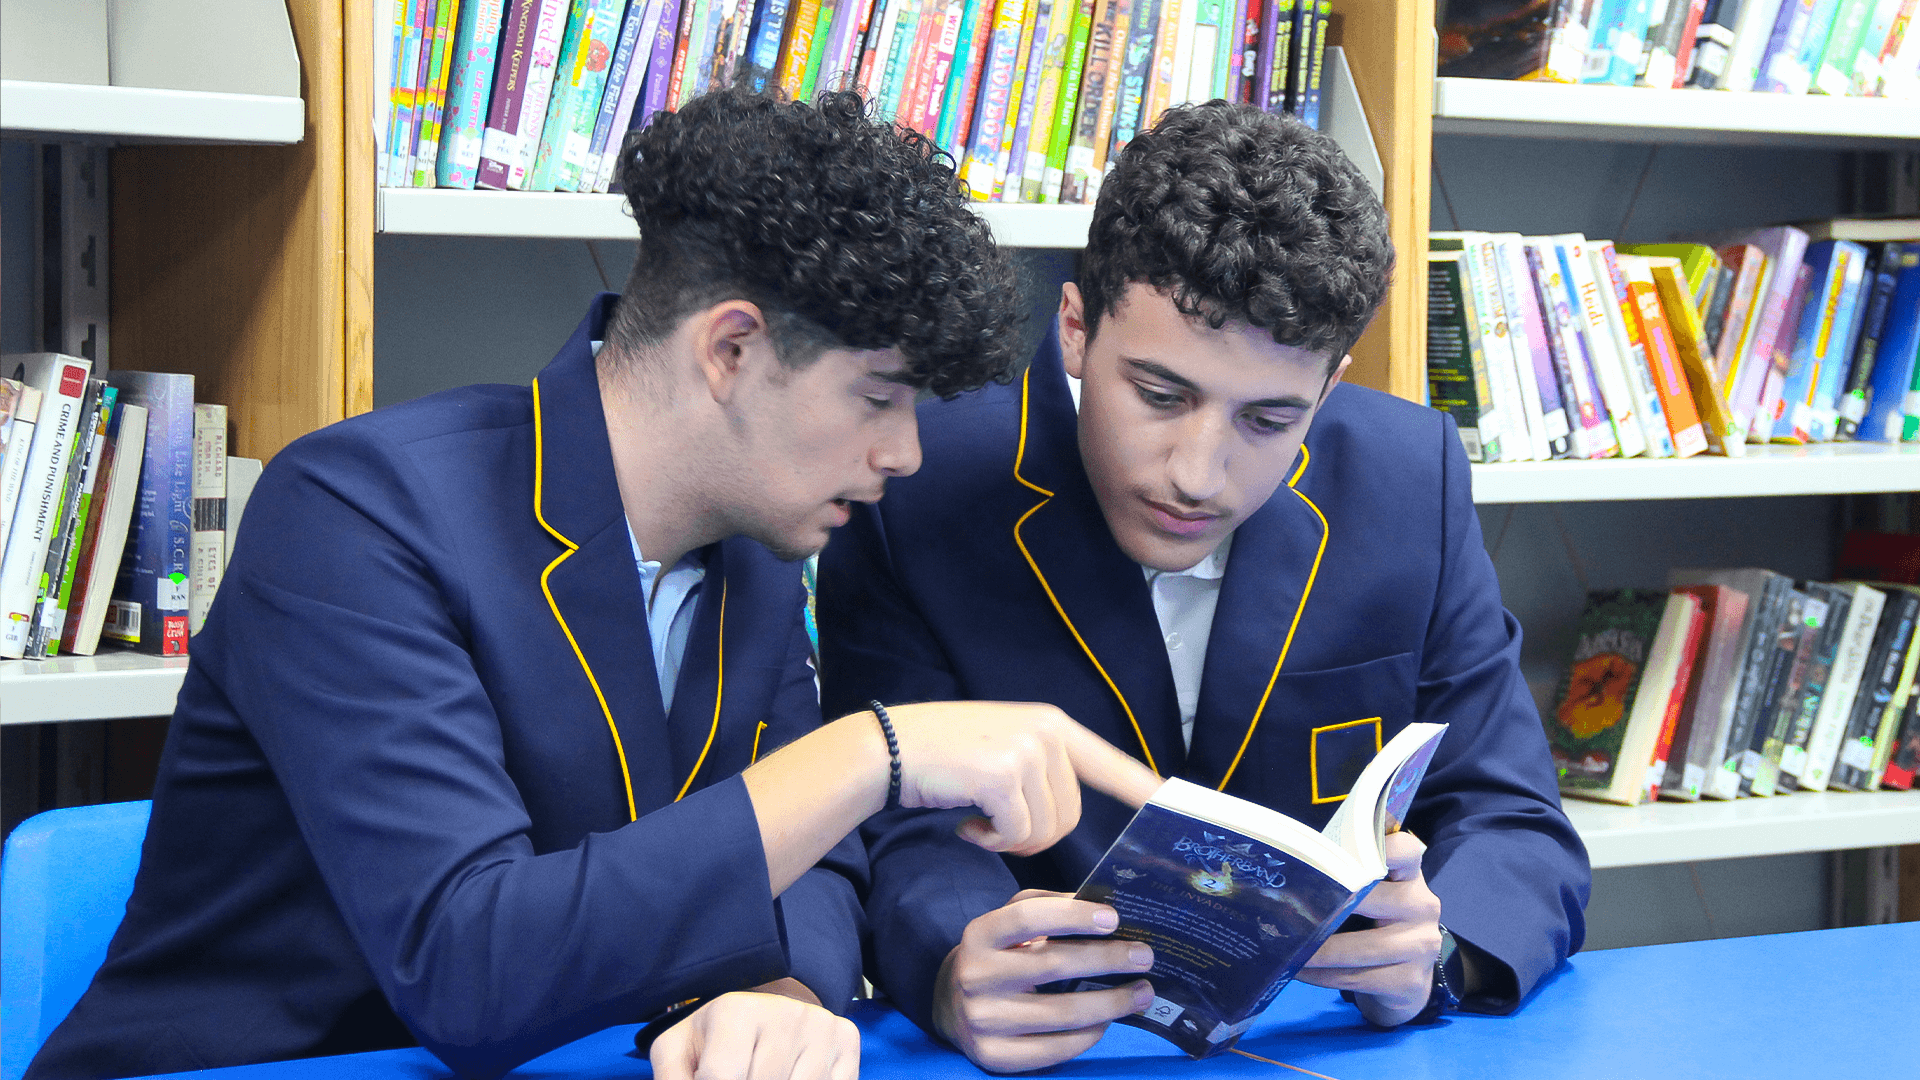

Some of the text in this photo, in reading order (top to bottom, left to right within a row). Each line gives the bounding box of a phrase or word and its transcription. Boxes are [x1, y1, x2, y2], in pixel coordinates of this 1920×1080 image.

[474, 2, 489, 42] sions
[942, 13, 958, 46] WILD
[503, 48, 522, 91] KEEPERS
[617, 47, 630, 62] in
[1110, 59, 1120, 70] in
[611, 62, 626, 83] the
[920, 72, 931, 84] in
[1069, 69, 1080, 81] in
[1078, 22, 1114, 138] KILL ORDER
[1106, 71, 1118, 88] the
[467, 70, 484, 128] LIZ RETTI
[603, 83, 620, 115] Field
[975, 43, 1018, 151] LIONBOY
[1065, 81, 1078, 100] the
[1060, 100, 1074, 126] Barn
[1580, 281, 1605, 327] Heidi
[32, 402, 71, 542] CRIME AND PUNISHMENT
[174, 450, 189, 476] Like
[213, 434, 222, 477] RICHARD
[171, 480, 188, 512] Light
[172, 536, 184, 571] S.C.R
[207, 547, 216, 589] EYES OF
[1172, 837, 1286, 888] BROTHERBAND
[1206, 878, 1217, 888] 2
[1150, 878, 1249, 923] THE INVADERS
